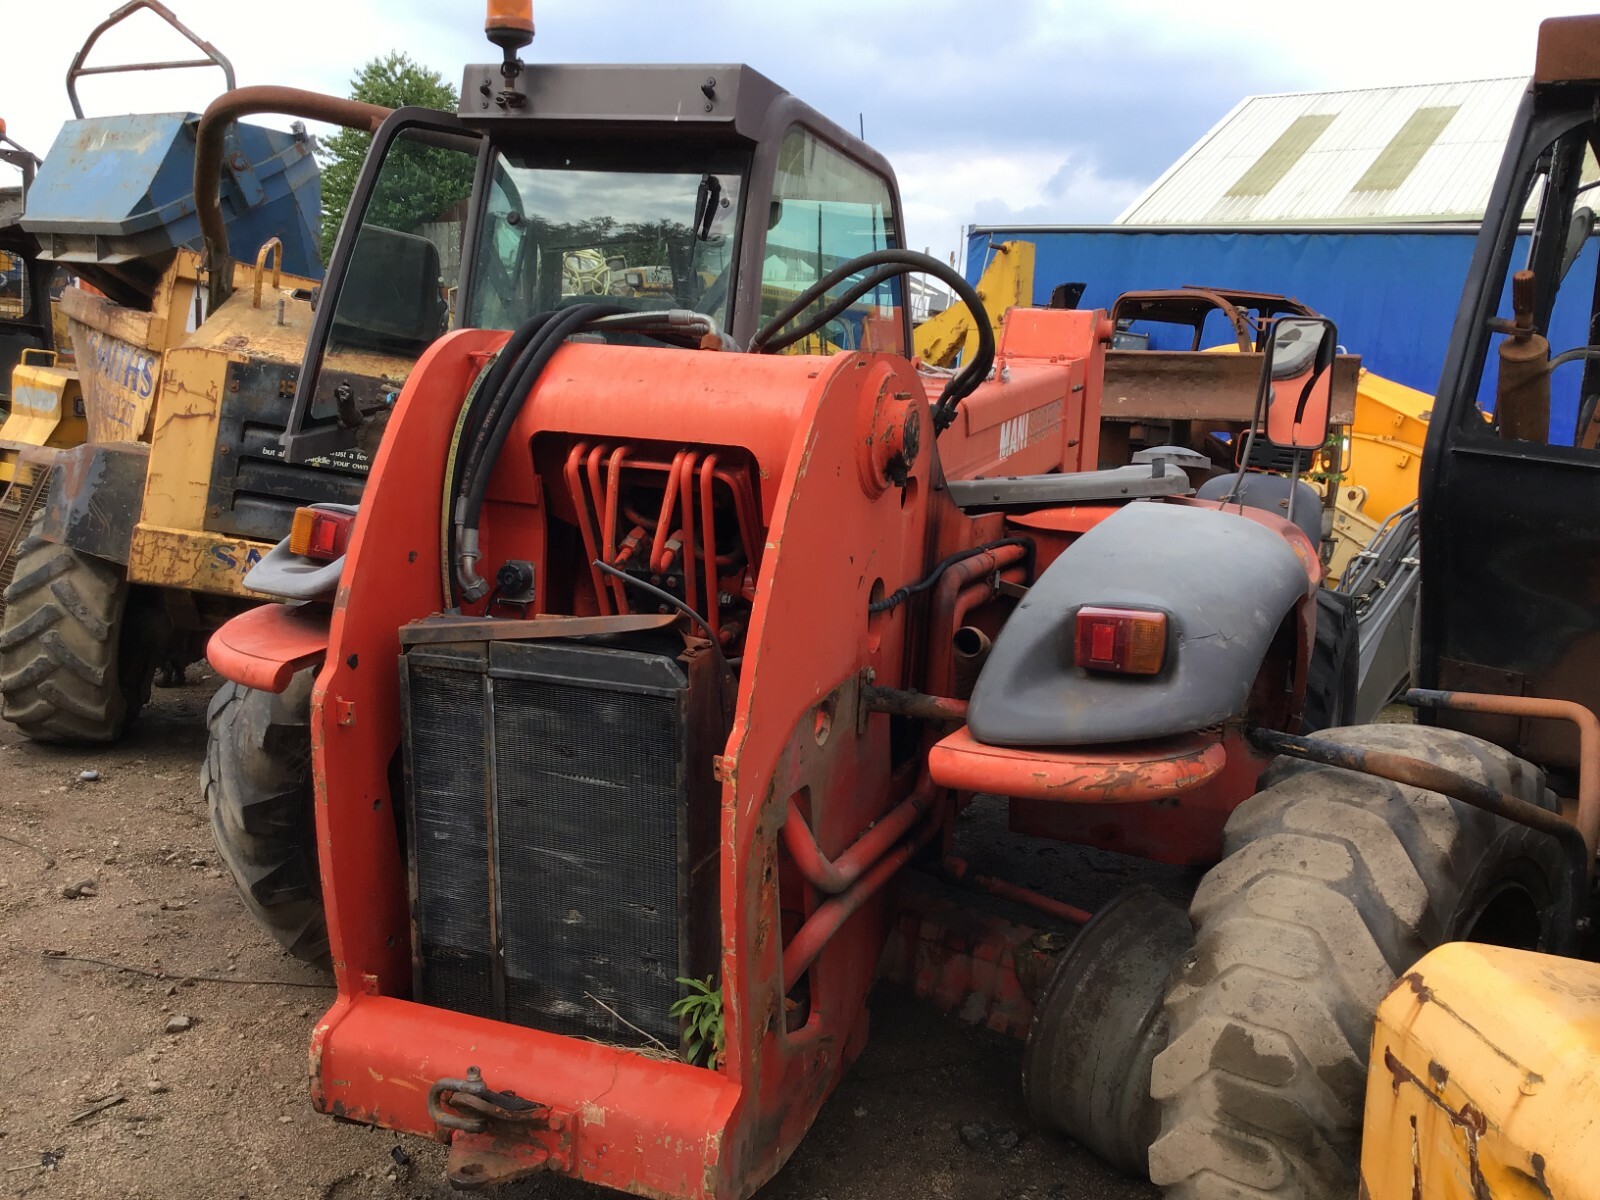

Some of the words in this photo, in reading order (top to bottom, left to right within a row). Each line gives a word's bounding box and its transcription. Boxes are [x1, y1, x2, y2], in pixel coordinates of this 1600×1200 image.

[262, 446, 275, 456] but
[332, 460, 350, 468] your
[351, 463, 369, 471] own
